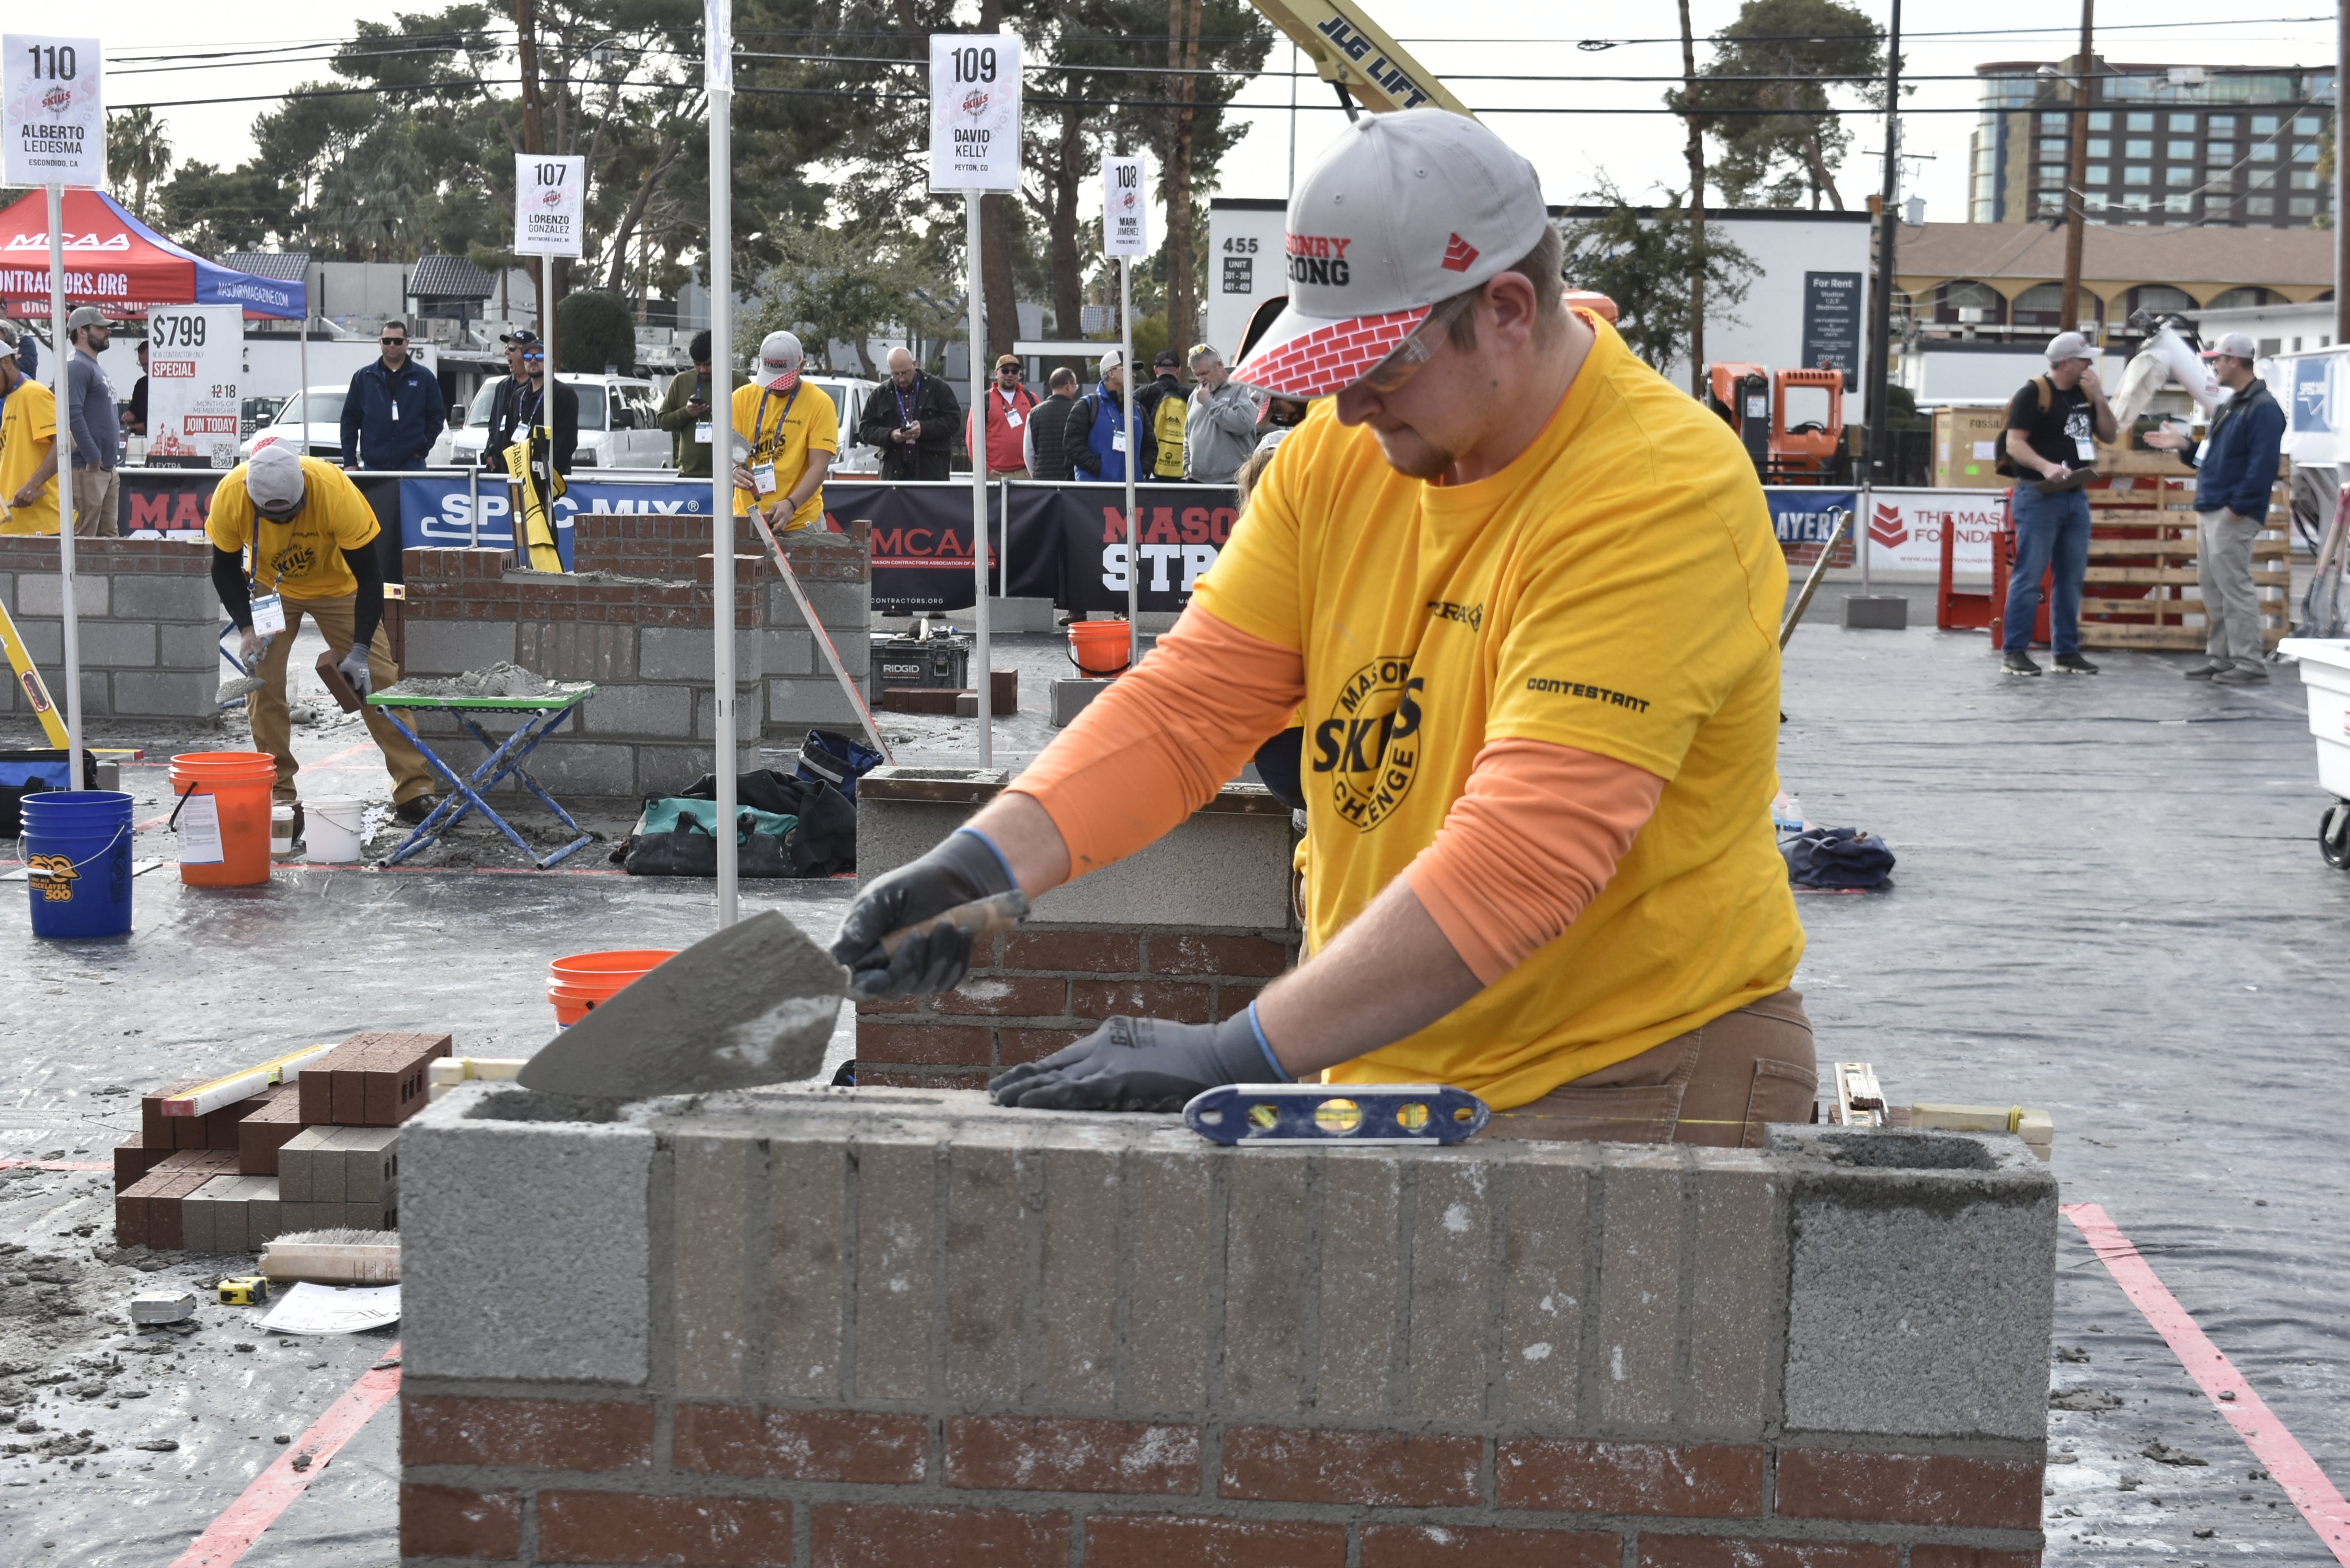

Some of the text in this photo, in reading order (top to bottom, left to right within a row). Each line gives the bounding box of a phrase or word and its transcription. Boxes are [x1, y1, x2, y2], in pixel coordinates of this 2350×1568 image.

[28, 45, 76, 80] 110
[951, 47, 996, 83] 109
[1316, 16, 1428, 109] JLG LIFT
[42, 91, 71, 108] SKILLS
[962, 94, 988, 111] SKILLS
[21, 124, 85, 140] ALBERTO
[954, 129, 990, 143] DAVID
[24, 141, 83, 154] LEDESMA
[955, 145, 988, 157] KELLY
[29, 159, 68, 167] ESCONDIDO,
[534, 163, 567, 186] 107
[1115, 165, 1137, 188] 108
[529, 214, 569, 224] LORENZO
[1119, 217, 1137, 226] MARK
[528, 224, 569, 234] GONZALEZ
[1116, 227, 1139, 236] JIMENEZ
[1223, 237, 1258, 253] 455
[1239, 272, 1250, 280] 309
[1813, 279, 1853, 288] For Rent
[217, 282, 289, 307] MASONRYMAGAZINE.COM
[153, 315, 206, 349] $799
[154, 363, 194, 376] SPECIAL
[212, 384, 236, 398] 12 18
[186, 418, 235, 432] JOIN TODAY
[883, 664, 920, 673] RIDGID
[1526, 677, 1650, 714] CONTESTANT
[45, 890, 72, 900] 500
